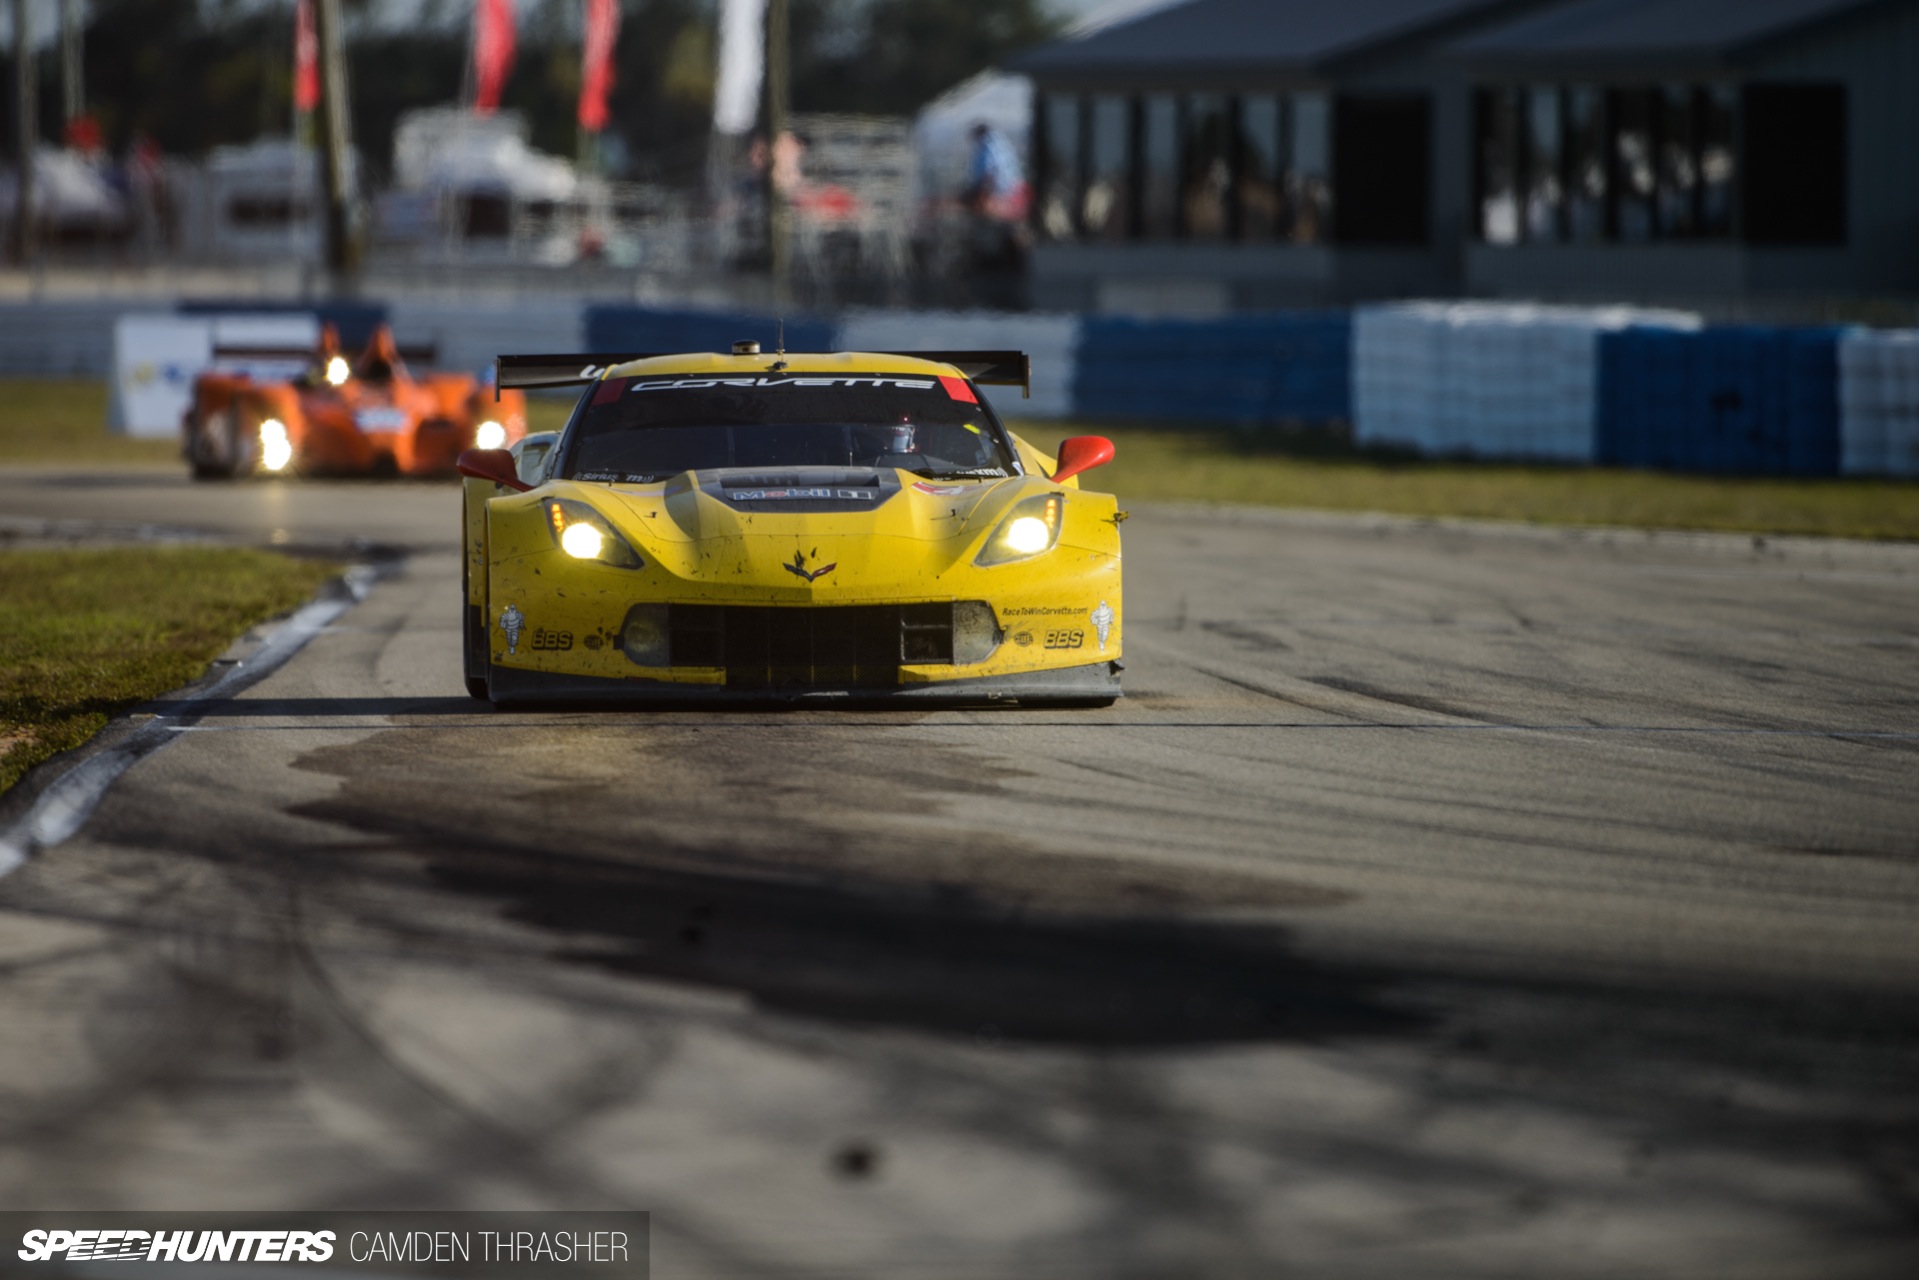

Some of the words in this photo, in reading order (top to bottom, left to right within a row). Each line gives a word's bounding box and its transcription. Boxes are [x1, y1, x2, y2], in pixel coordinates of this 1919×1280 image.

[631, 377, 936, 392] CORVETTE
[733, 488, 831, 501] Mobil
[1002, 606, 1088, 616] RaceToWinCorvette.com
[532, 631, 573, 650] BBS
[1044, 629, 1084, 649] BBS
